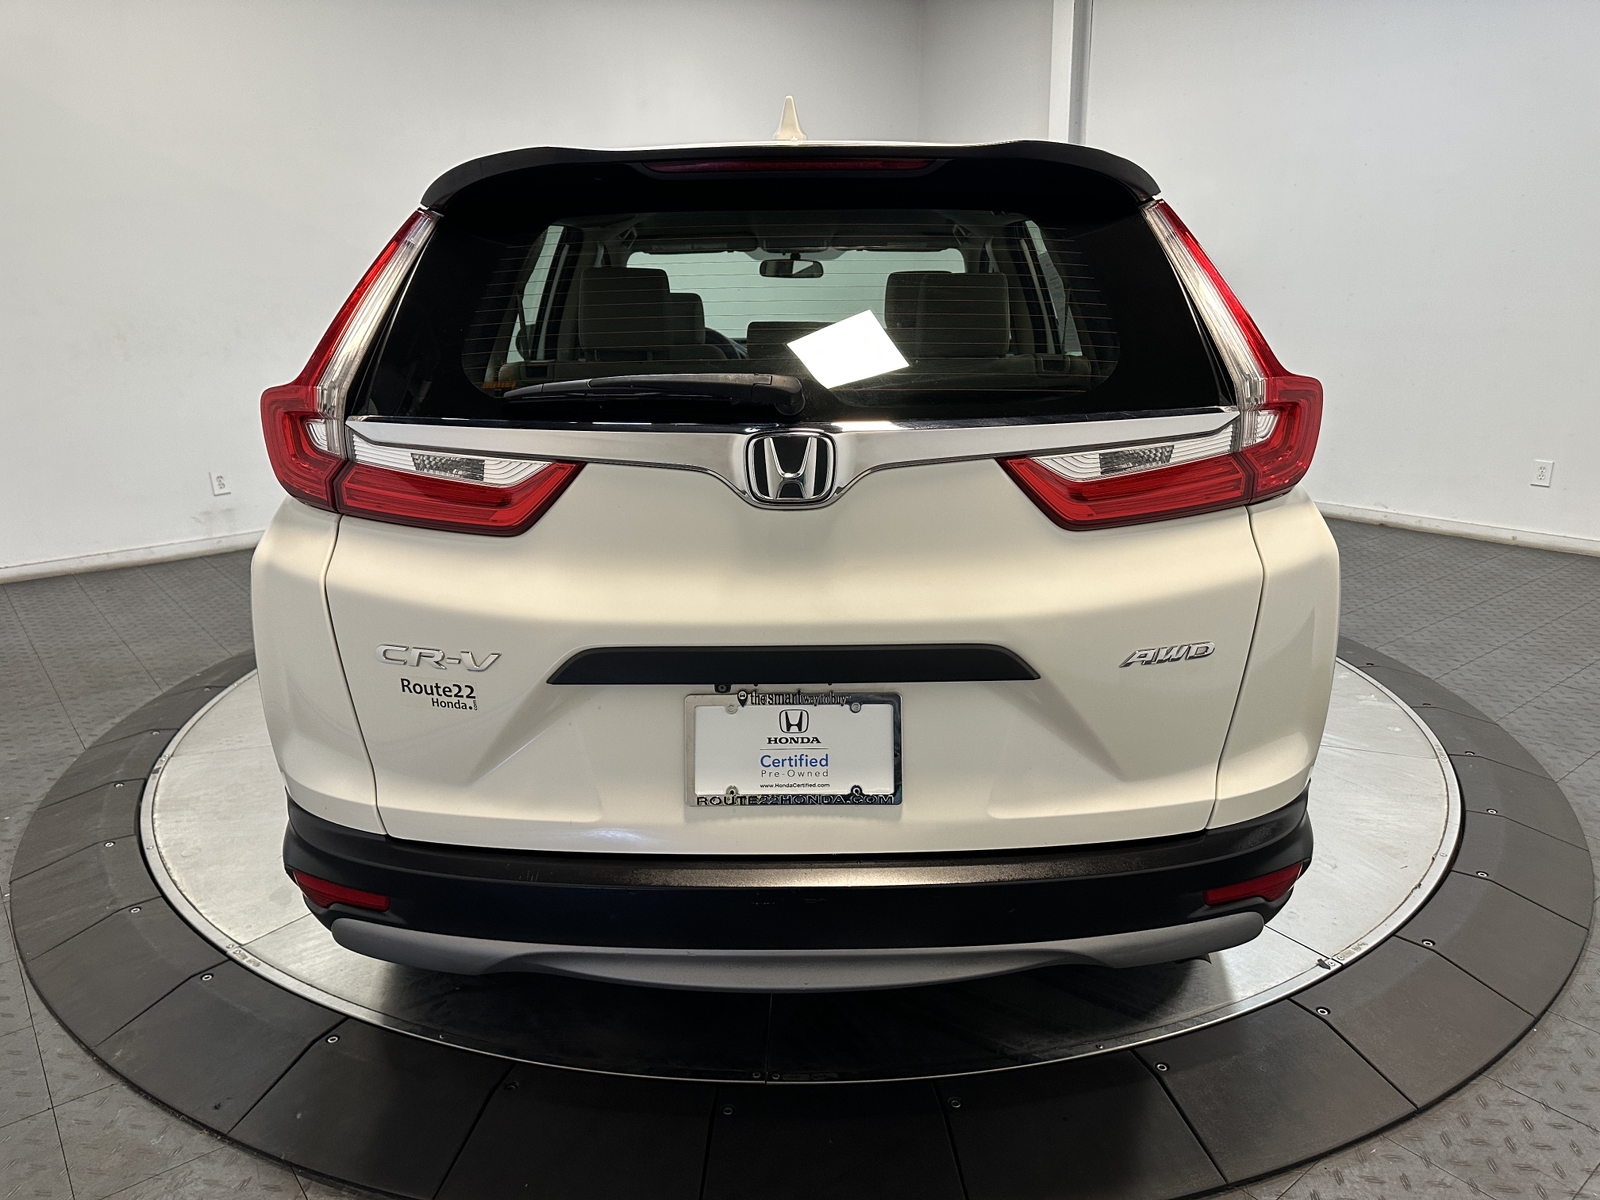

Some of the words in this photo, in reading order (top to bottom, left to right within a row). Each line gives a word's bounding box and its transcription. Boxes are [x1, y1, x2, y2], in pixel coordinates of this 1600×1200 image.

[375, 643, 502, 672] CR-V
[1119, 640, 1216, 668] AWD
[400, 678, 476, 699] Route22
[766, 736, 822, 744] HONDA
[760, 754, 829, 768] Certified
[761, 769, 829, 778] Pre-Owned
